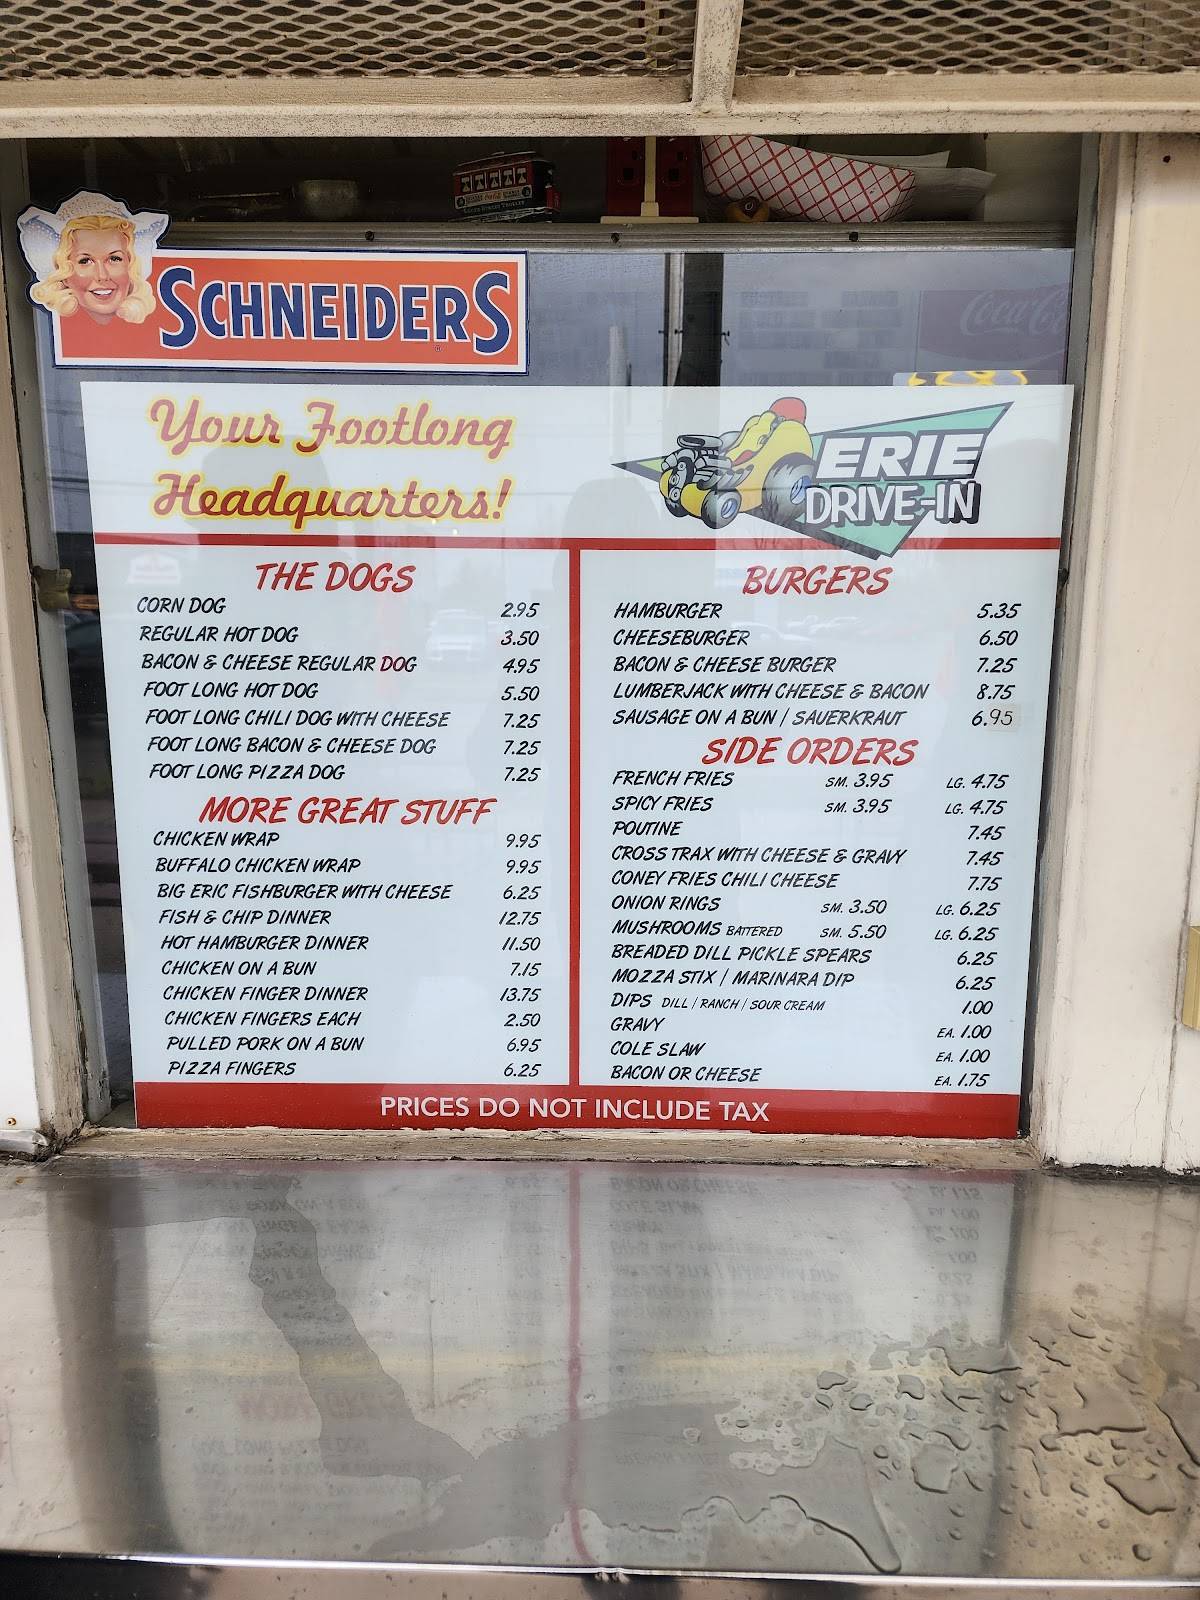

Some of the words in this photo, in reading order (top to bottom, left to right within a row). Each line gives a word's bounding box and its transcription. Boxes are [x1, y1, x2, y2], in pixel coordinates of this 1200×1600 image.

[157, 265, 512, 355] SCHNEIDERS
[150, 398, 281, 456] Your
[296, 401, 513, 459] Footlong
[815, 433, 984, 479] ERIE
[153, 474, 512, 529] Headquarters!
[805, 481, 977, 524] DRIVE-IN
[256, 562, 319, 591] THE
[325, 562, 416, 593] DOGS
[742, 565, 893, 595] BURGERS
[137, 596, 185, 613] CORN
[189, 597, 226, 615] DOG
[501, 602, 540, 618] 2.95
[614, 602, 722, 620] HAMBURGER
[977, 602, 1022, 619] 5.35
[139, 625, 218, 642] REGULAR
[223, 626, 261, 642] HOT
[261, 626, 299, 643] DOG
[501, 630, 539, 646] 3.50
[613, 629, 750, 647] CHEESEBURGER
[979, 630, 1018, 646] 6.50
[141, 653, 200, 670] BACON
[203, 654, 217, 670] &
[222, 654, 294, 671] CHEESE
[297, 655, 376, 672] REGULAR
[380, 656, 417, 672] DOG
[503, 657, 540, 674] 4.95
[612, 656, 672, 672] BACON
[674, 657, 688, 672] &
[693, 656, 765, 673] CHEESE
[767, 656, 838, 672] BURGER
[977, 657, 1018, 673] 7.25
[143, 681, 190, 697] FOOT
[191, 682, 239, 698] LONG
[243, 681, 281, 698] HOT
[281, 682, 318, 698] DOG
[501, 684, 540, 701] 5.50
[613, 682, 729, 700] LUMBERJACK
[730, 682, 774, 700] WITH
[775, 682, 848, 700] CHEESE
[849, 684, 864, 699] &
[869, 682, 930, 699] BACON
[977, 683, 1015, 700] 8.75
[145, 708, 192, 725] FOOT
[193, 709, 240, 727] LONG
[245, 709, 292, 727] CHILI
[296, 710, 337, 727] DOG
[336, 711, 379, 728] WITH
[381, 711, 451, 727] CHEESE
[504, 713, 541, 728] 7.25
[612, 709, 693, 726] SAUSAGE
[695, 709, 723, 725] ON
[725, 709, 737, 725] A
[740, 708, 778, 727] BUN
[779, 707, 790, 728] /
[792, 709, 908, 726] SAUERKRAUT
[972, 709, 1013, 726] 6.95
[702, 736, 782, 765] SIDE
[787, 737, 919, 766] ORDERS
[612, 770, 682, 786] FRENCH
[683, 771, 735, 786] FRIES
[825, 776, 848, 788] SM.
[854, 773, 894, 788] 3.95
[946, 777, 965, 789] LG.
[971, 773, 1009, 789] 4.75
[199, 796, 292, 824] MORE
[298, 797, 400, 824] GREAT
[401, 798, 498, 825] STUFF
[153, 831, 228, 847] CHICKEN
[231, 832, 280, 848] WRAP
[506, 834, 541, 848] 9.95
[612, 820, 684, 837] POUTINE
[968, 825, 1006, 840] 7.45
[611, 870, 667, 886] CONEY
[667, 871, 719, 887] FRIES
[721, 872, 768, 887] CHILI
[770, 872, 840, 888] CHEESE
[968, 876, 1002, 891] 7.75
[157, 883, 185, 899] BIG
[190, 884, 228, 899] ERIC
[232, 883, 338, 899] FISHBURGER
[341, 884, 383, 899] WITH
[385, 884, 454, 900] CHEESE
[503, 885, 542, 900] 6.25
[611, 895, 666, 910] ONION
[668, 896, 721, 912] RINGS
[821, 902, 843, 913] SM.
[849, 899, 887, 914] 3.50
[936, 904, 954, 915] LG.
[960, 901, 1001, 917] 6.25
[159, 909, 202, 924] FISH
[203, 910, 218, 924] &
[222, 910, 263, 925] CHIP
[267, 909, 331, 925] DINNER
[499, 911, 542, 926] 12.75
[611, 919, 722, 936] MUSHROOMS
[726, 923, 783, 937] BATTERED
[820, 928, 842, 938] SM.
[848, 925, 887, 939] 5.50
[934, 929, 953, 941] LG.
[958, 926, 999, 942] 6.25
[160, 934, 196, 950] HOT
[197, 935, 301, 951] HAMBURGER
[304, 935, 369, 951] DINNER
[502, 937, 541, 951] 11.50
[611, 944, 689, 959] BREADED
[693, 945, 731, 960] DILL
[737, 946, 800, 962] PICKLE
[803, 948, 872, 964] SPEARS
[957, 951, 997, 966] 6.25
[161, 960, 235, 976] CHICKEN
[238, 961, 263, 975] ON
[267, 960, 279, 975] A
[282, 960, 317, 975] BUN
[510, 962, 542, 976] 7.15
[611, 992, 652, 1008] DIPS
[661, 997, 688, 1008] DILL
[691, 997, 698, 1010] /
[700, 998, 741, 1009] RANCH
[741, 998, 748, 1011] /
[749, 1000, 781, 1010] SOUR
[784, 1000, 826, 1011] CREAM
[960, 1000, 993, 1016] 1.00
[165, 1010, 237, 1026] CHICKEN
[241, 1011, 312, 1026] FINGERS
[317, 1011, 362, 1026] EACH
[504, 1013, 541, 1027] 2.50
[611, 1017, 666, 1032] GRAVY
[937, 1028, 955, 1039] EA.
[960, 1024, 992, 1040] 1.00
[611, 1040, 655, 1056] COLE
[657, 1042, 706, 1056] SLAW
[936, 1052, 953, 1063] EA.
[959, 1049, 990, 1063] 1.00
[168, 1061, 221, 1076] PIZZA
[225, 1061, 296, 1077] FINGERS
[504, 1063, 542, 1077] 6.25
[611, 1064, 666, 1080] BACON
[668, 1065, 692, 1080] OR
[695, 1066, 762, 1082] CHEESE
[934, 1076, 952, 1086] EA.
[957, 1073, 990, 1087] 1.75
[381, 1096, 469, 1117] PRICES
[479, 1097, 520, 1118] DO
[529, 1098, 587, 1119] NOT
[595, 1099, 710, 1121] INCLUDE
[719, 1102, 770, 1122] TAX
